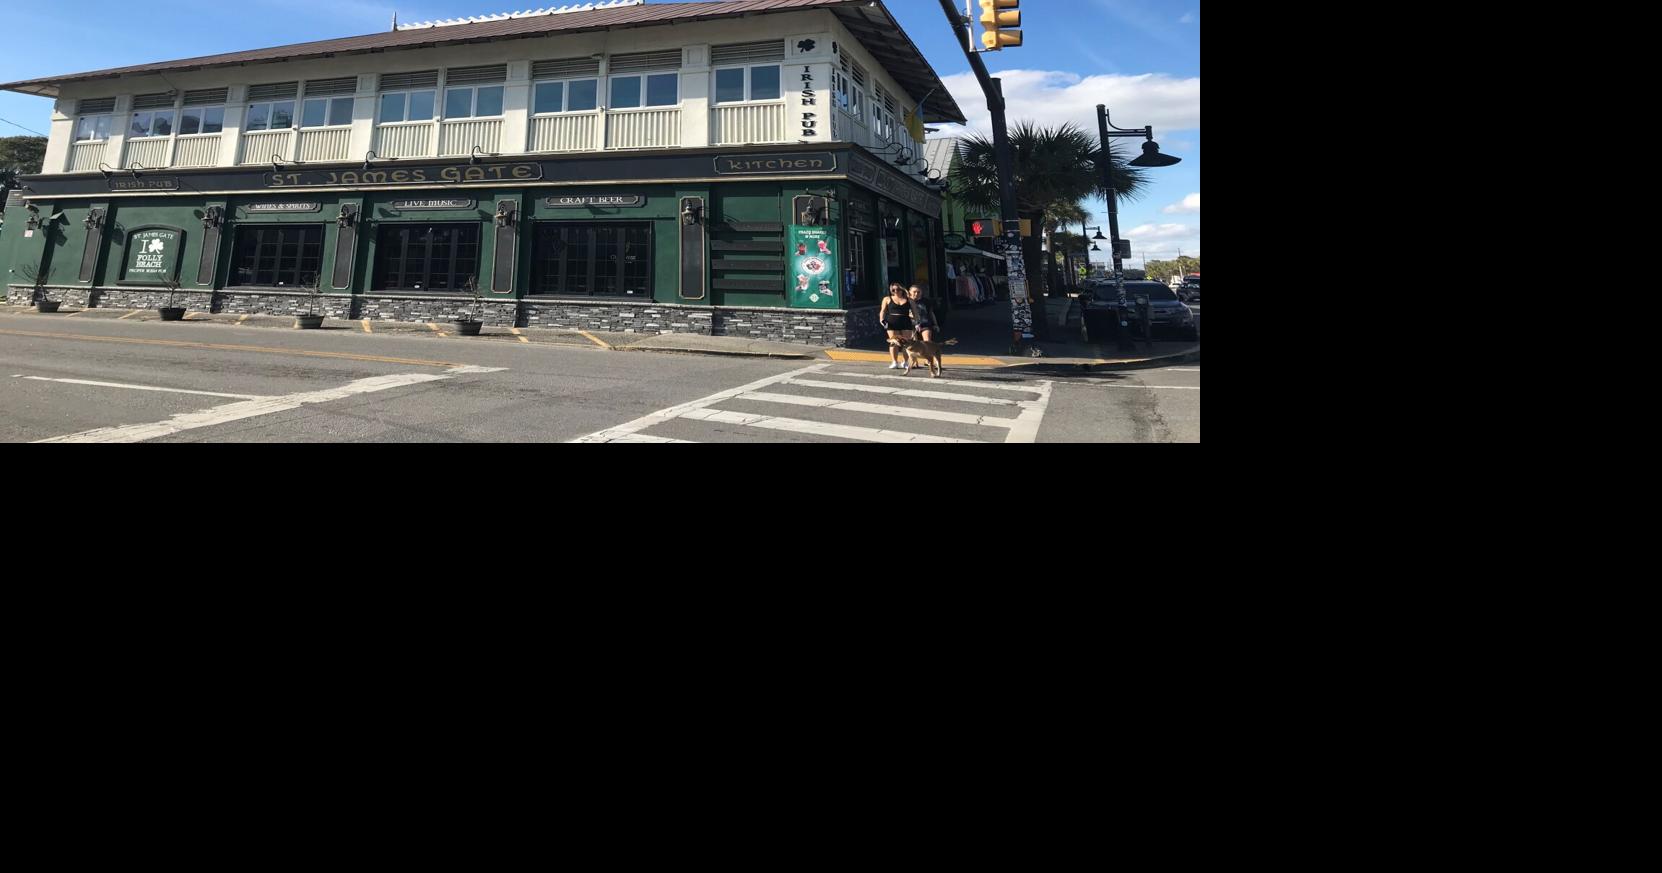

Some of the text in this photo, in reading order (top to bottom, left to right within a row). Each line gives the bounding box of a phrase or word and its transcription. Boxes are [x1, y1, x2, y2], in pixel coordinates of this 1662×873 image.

[800, 65, 818, 136] IRISH PUB
[727, 157, 823, 170] KITCHEN
[272, 165, 532, 186] ST. JAMES GATE
[148, 180, 173, 189] PUB
[428, 199, 457, 207] MUSIC
[159, 231, 174, 239] GATE
[138, 239, 150, 254] I
